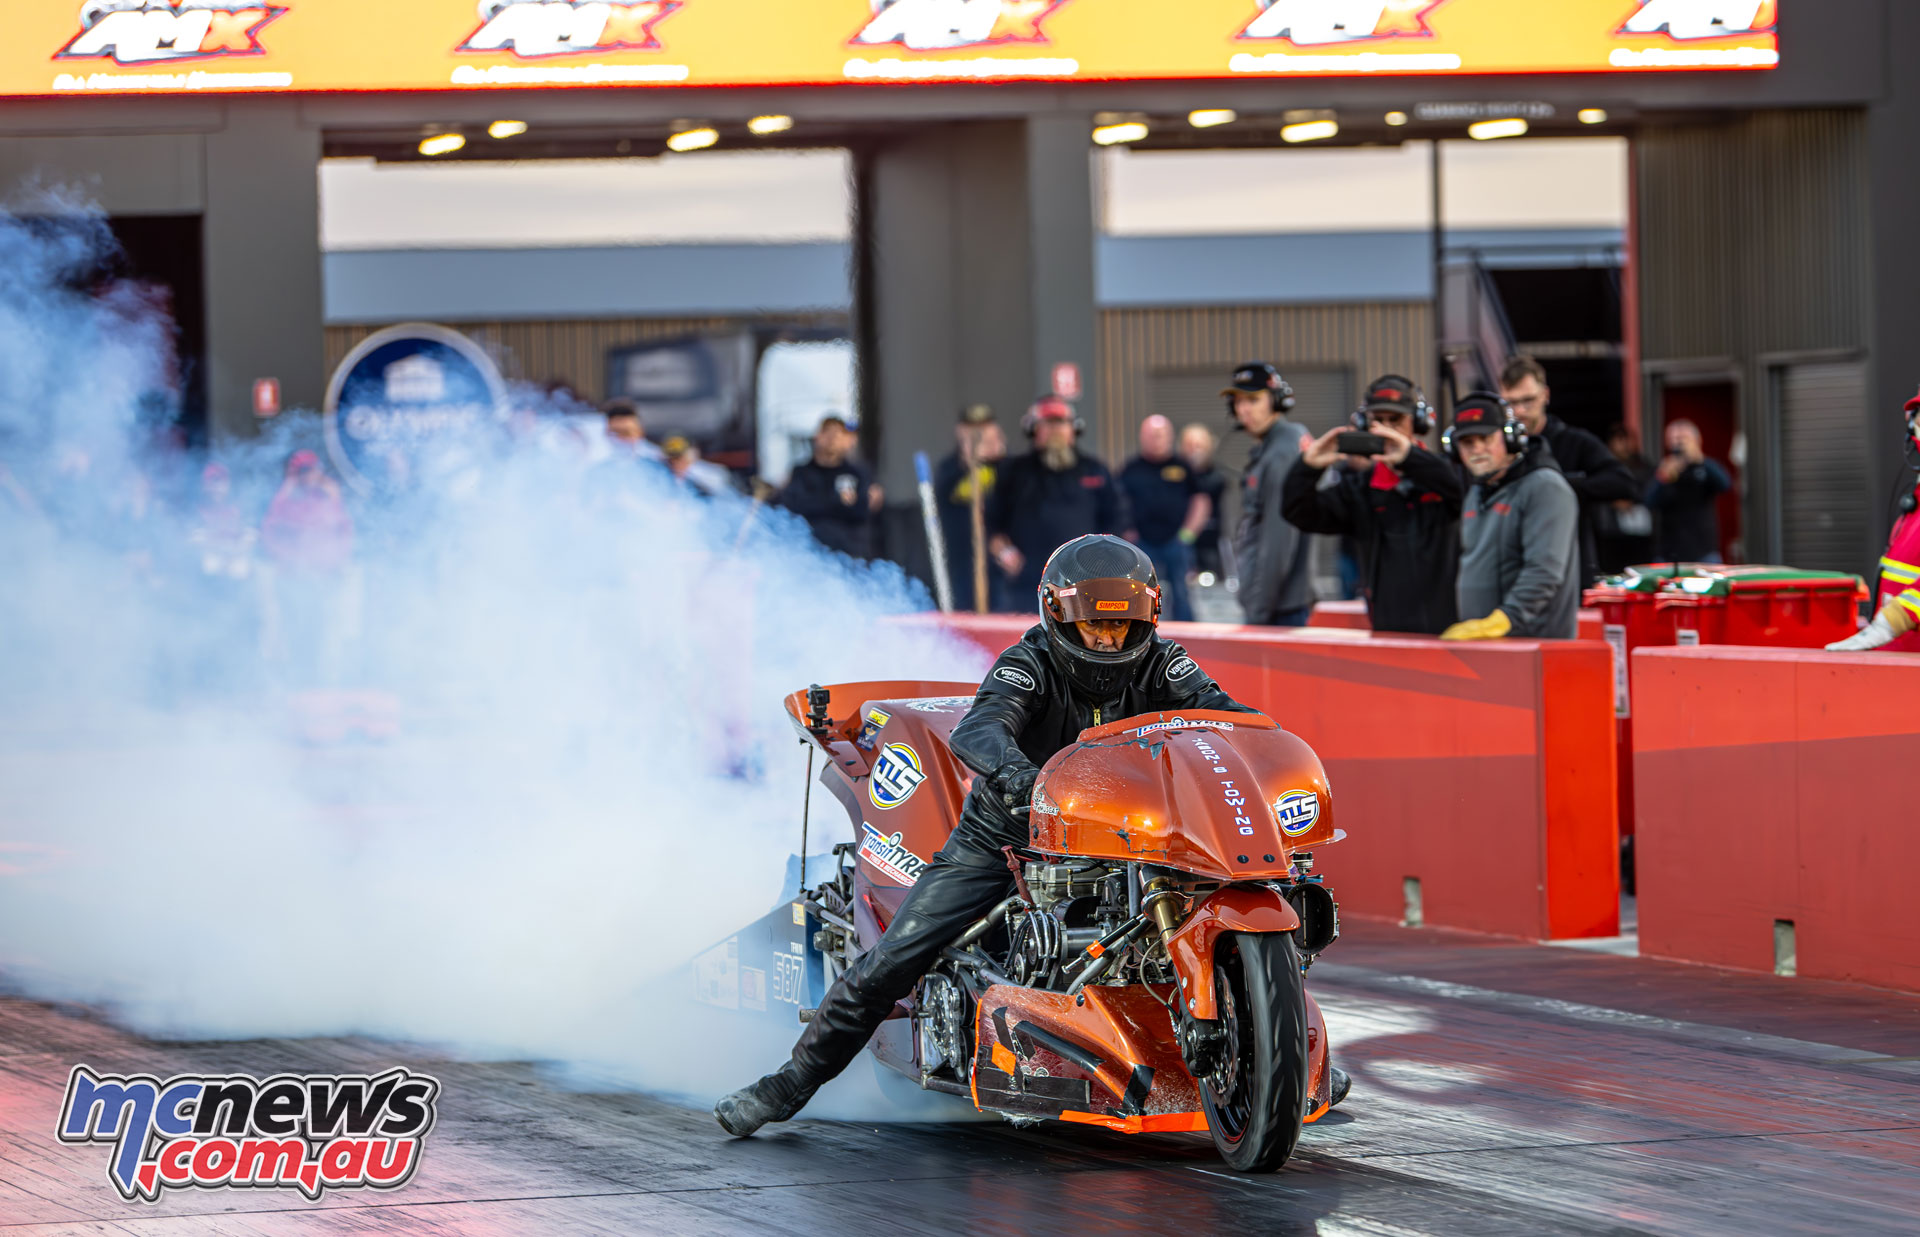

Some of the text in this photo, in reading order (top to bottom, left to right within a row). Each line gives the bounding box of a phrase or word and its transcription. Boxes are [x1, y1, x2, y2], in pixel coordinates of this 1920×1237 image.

[1098, 601, 1126, 610] SIMPSON
[1000, 669, 1032, 686] vanson
[873, 745, 926, 796] JTS
[1219, 780, 1255, 836] TOWING
[1274, 793, 1317, 827] JTS
[858, 823, 928, 878] Transit TYRE
